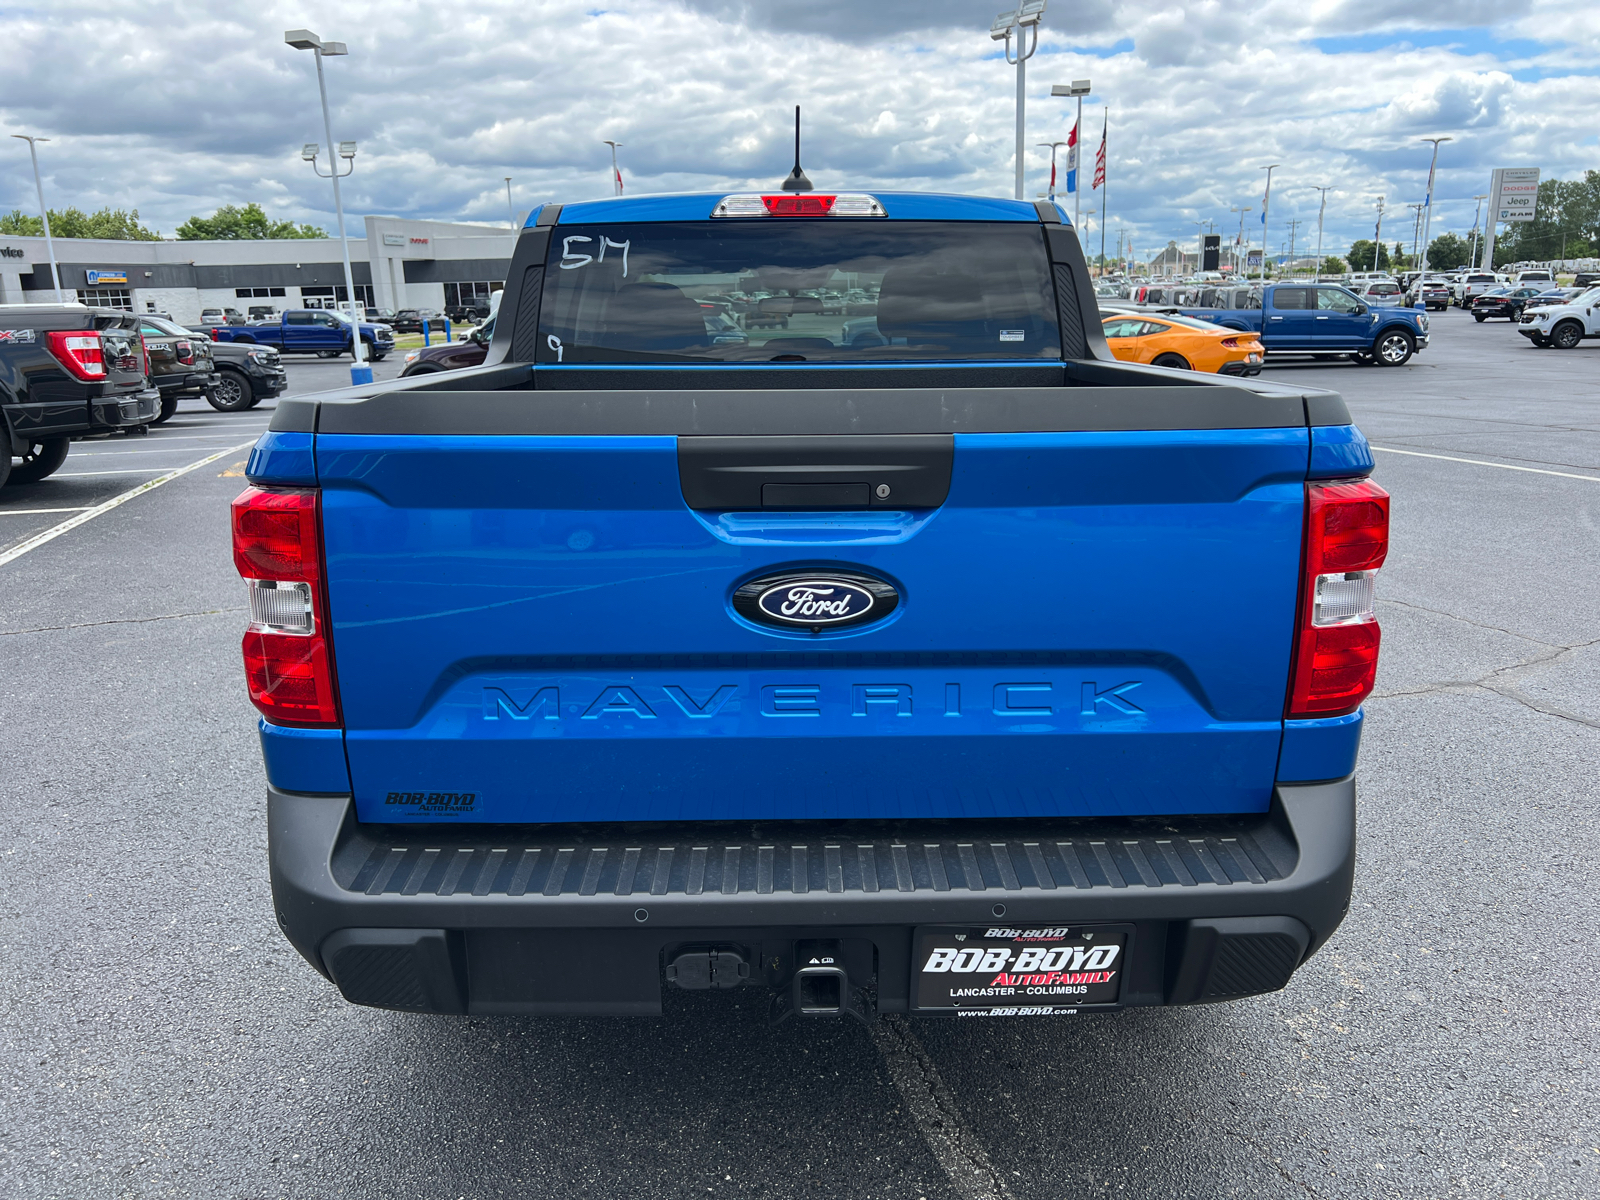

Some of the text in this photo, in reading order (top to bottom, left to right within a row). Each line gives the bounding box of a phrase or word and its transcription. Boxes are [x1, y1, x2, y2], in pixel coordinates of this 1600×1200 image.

[1507, 197, 1530, 206] Jeep
[781, 587, 852, 616] Ford
[482, 681, 1147, 721] MAVERICK
[984, 927, 1069, 938] BOB-BOYD
[922, 945, 1120, 972] BOB-BOYD
[949, 987, 1015, 997] LANCASTER
[1026, 985, 1088, 995] COLUMBUS
